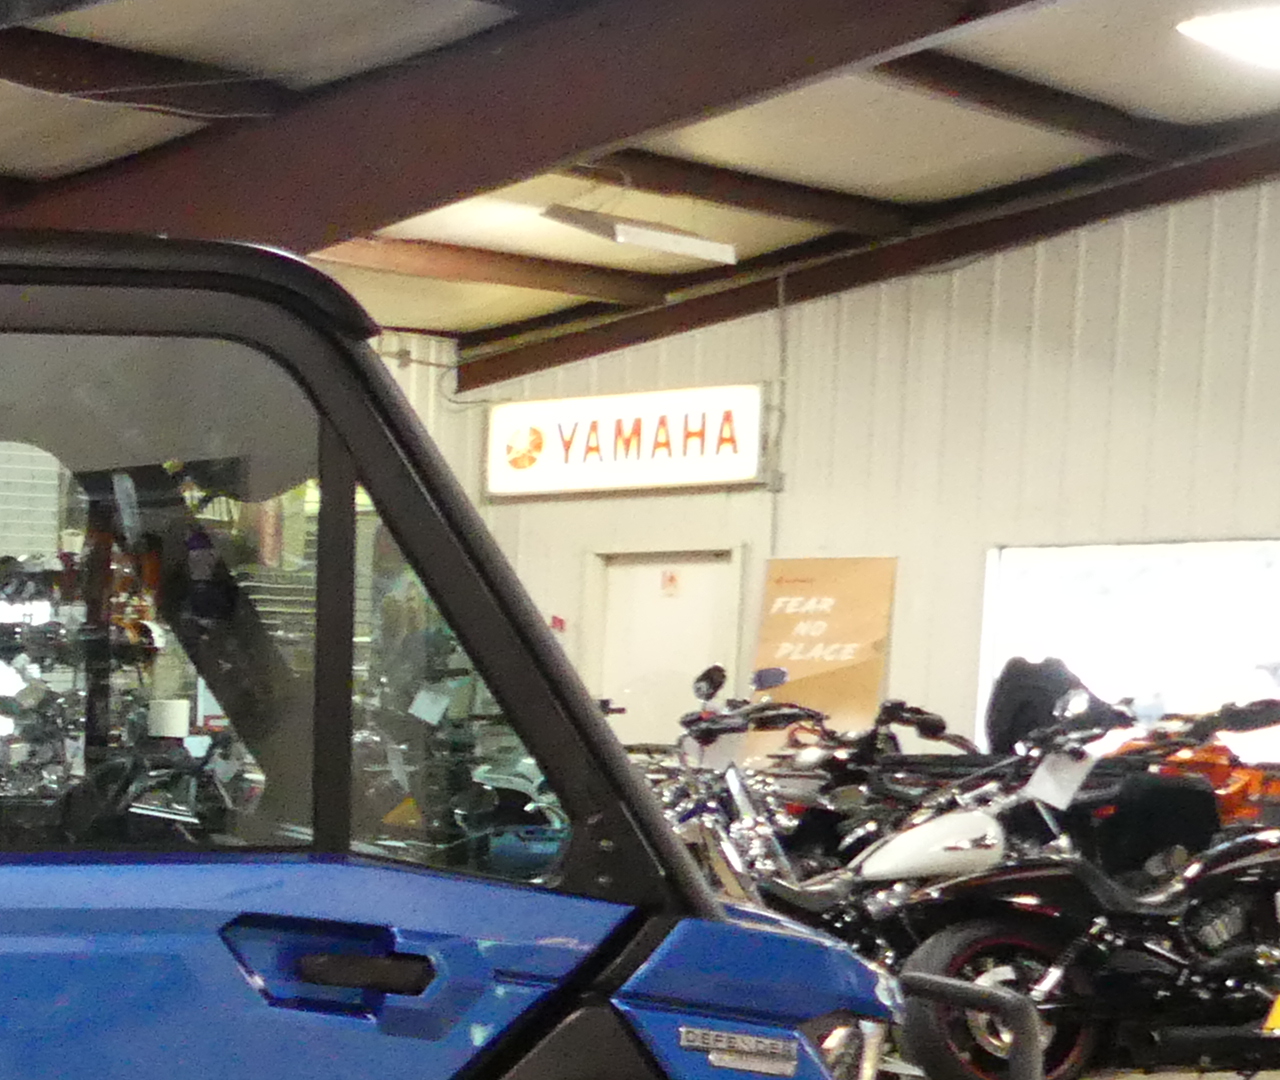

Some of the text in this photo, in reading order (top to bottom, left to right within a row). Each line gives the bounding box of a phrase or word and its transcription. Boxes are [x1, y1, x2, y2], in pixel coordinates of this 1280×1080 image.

[557, 410, 738, 464] YAMAHA
[770, 597, 836, 613] FEAR
[792, 620, 828, 636] NO
[774, 642, 860, 660] PLACE
